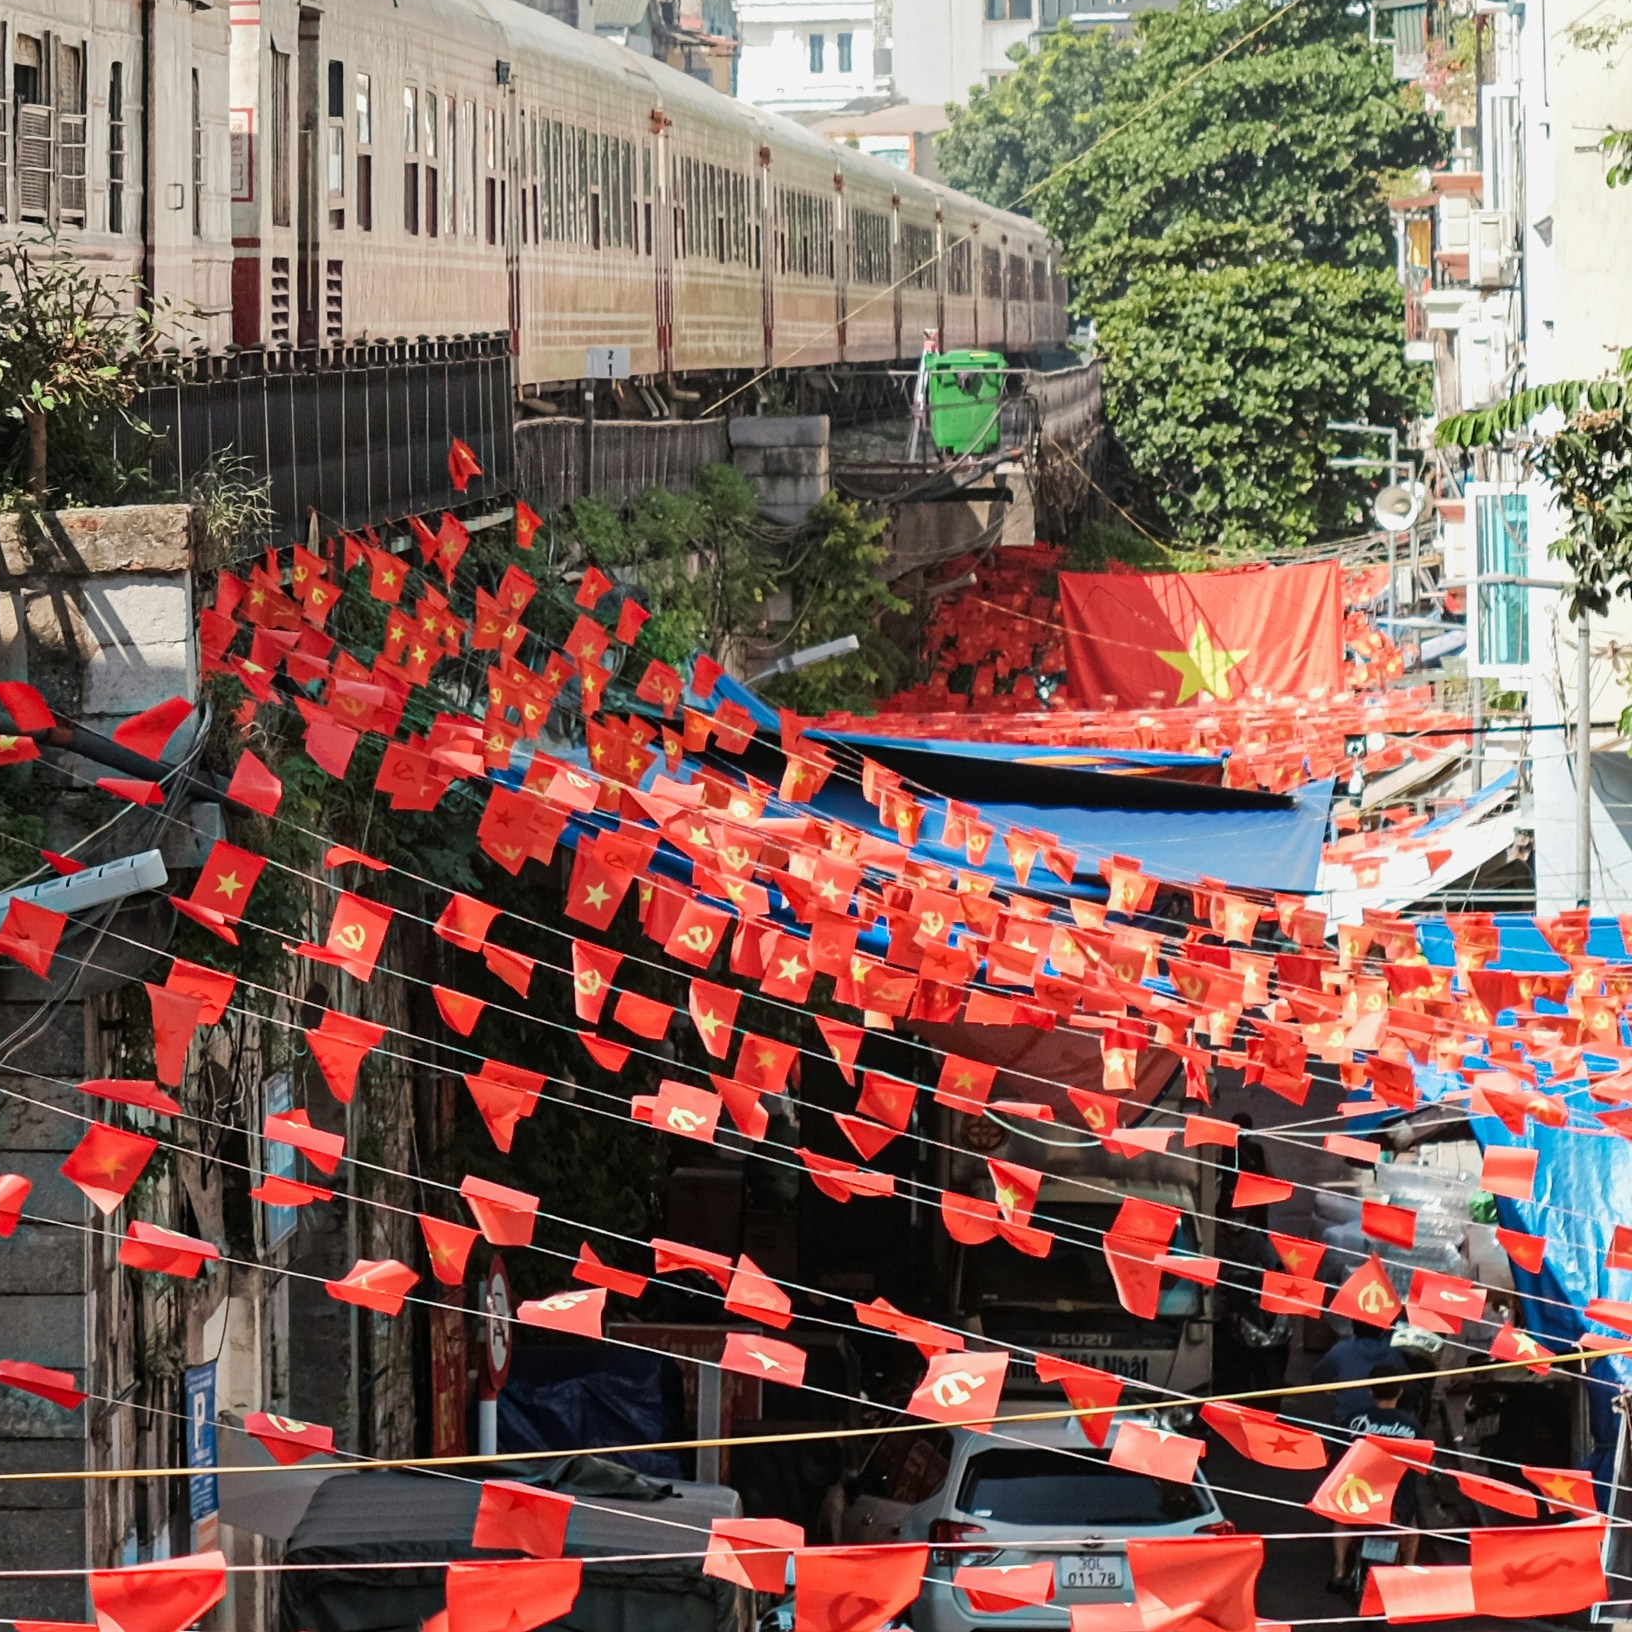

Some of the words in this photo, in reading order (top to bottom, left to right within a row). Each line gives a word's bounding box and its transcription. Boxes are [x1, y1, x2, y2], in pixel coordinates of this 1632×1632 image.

[607, 349, 615, 360] 2
[1050, 1333, 1112, 1347] ISUZU
[193, 1392, 206, 1449] P
[1067, 1571, 1117, 1586] 011.78
